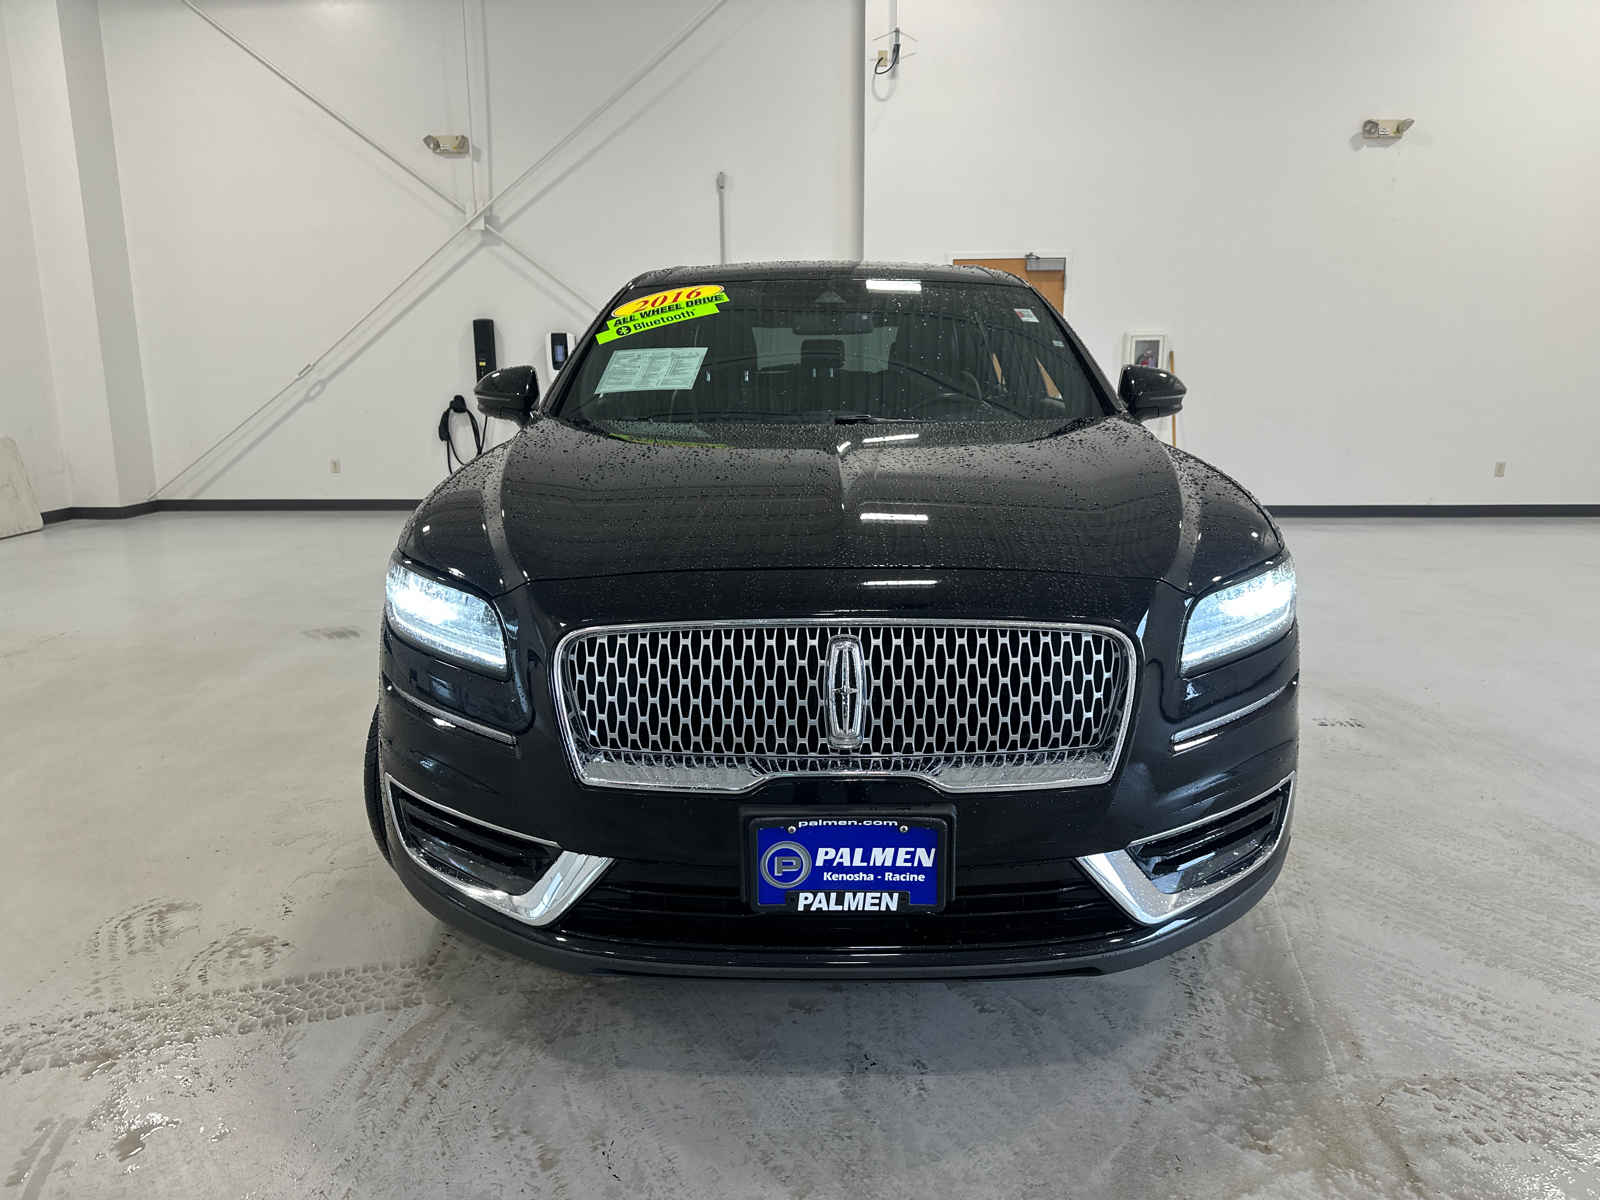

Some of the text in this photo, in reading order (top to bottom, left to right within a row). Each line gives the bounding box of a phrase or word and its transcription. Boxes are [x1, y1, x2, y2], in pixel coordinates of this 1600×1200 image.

[632, 287, 704, 313] 2016
[613, 294, 724, 328] ALL WHEEL DRIVE
[798, 819, 898, 828] palmen.com
[815, 847, 936, 867] PALMEN
[823, 871, 874, 882] Kenosha
[885, 872, 926, 882] Racine
[797, 892, 899, 911] PALMEN
